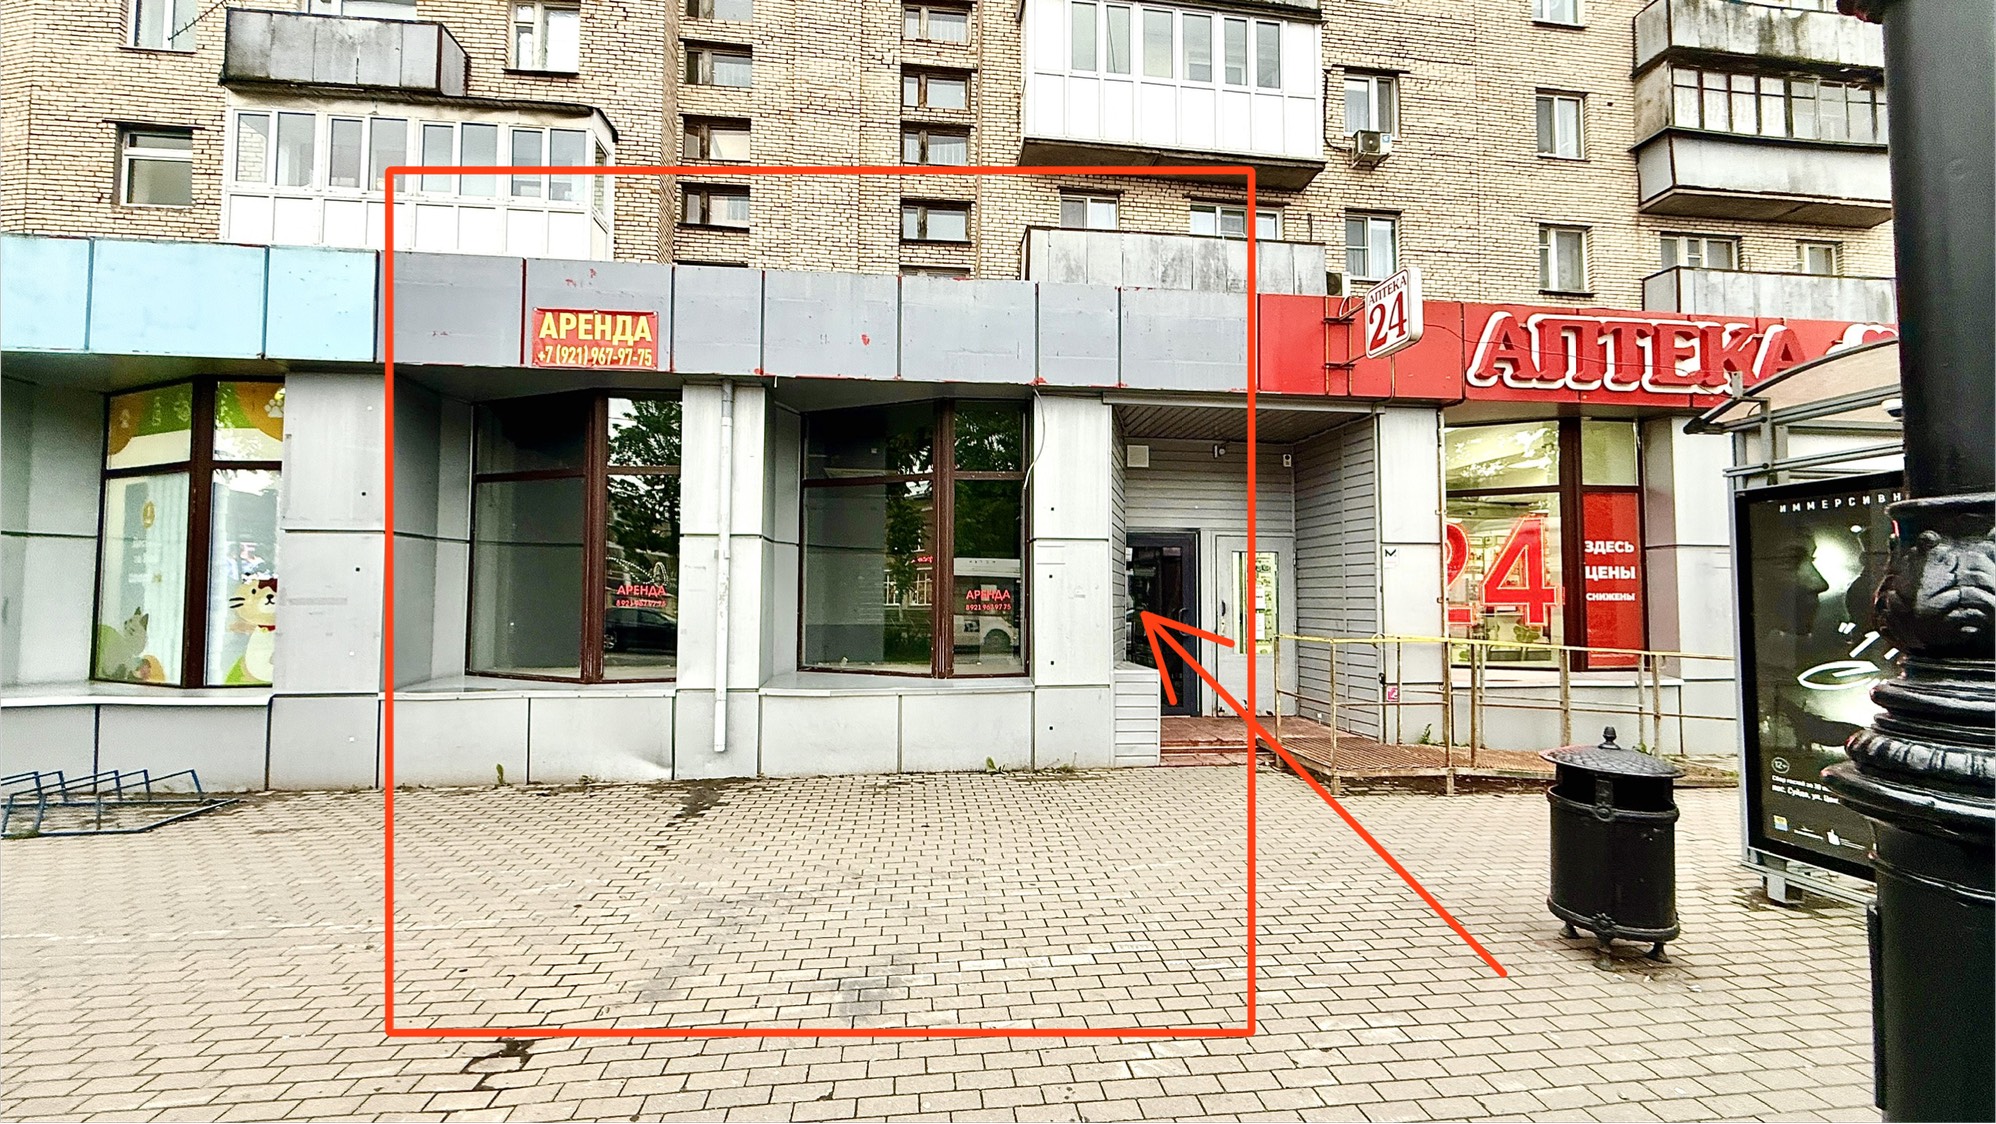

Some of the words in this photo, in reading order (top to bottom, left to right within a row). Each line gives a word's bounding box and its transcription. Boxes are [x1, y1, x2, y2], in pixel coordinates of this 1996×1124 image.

[1368, 275, 1407, 306] АПТЕКА
[538, 312, 653, 346] АРЕНДА
[1369, 290, 1408, 352] 24
[538, 345, 554, 364] +7
[555, 344, 589, 366] (921)
[591, 346, 653, 367] 967-97-75
[1467, 311, 1807, 395] АПТЕКА
[1584, 540, 1635, 554] ЗДЕСЬ
[1584, 565, 1636, 581] ЦЕНЫ
[616, 585, 667, 597] АРЕНДА
[965, 589, 1011, 601] АРЕНДА
[1585, 592, 1636, 602] СНИЖЕНЫ
